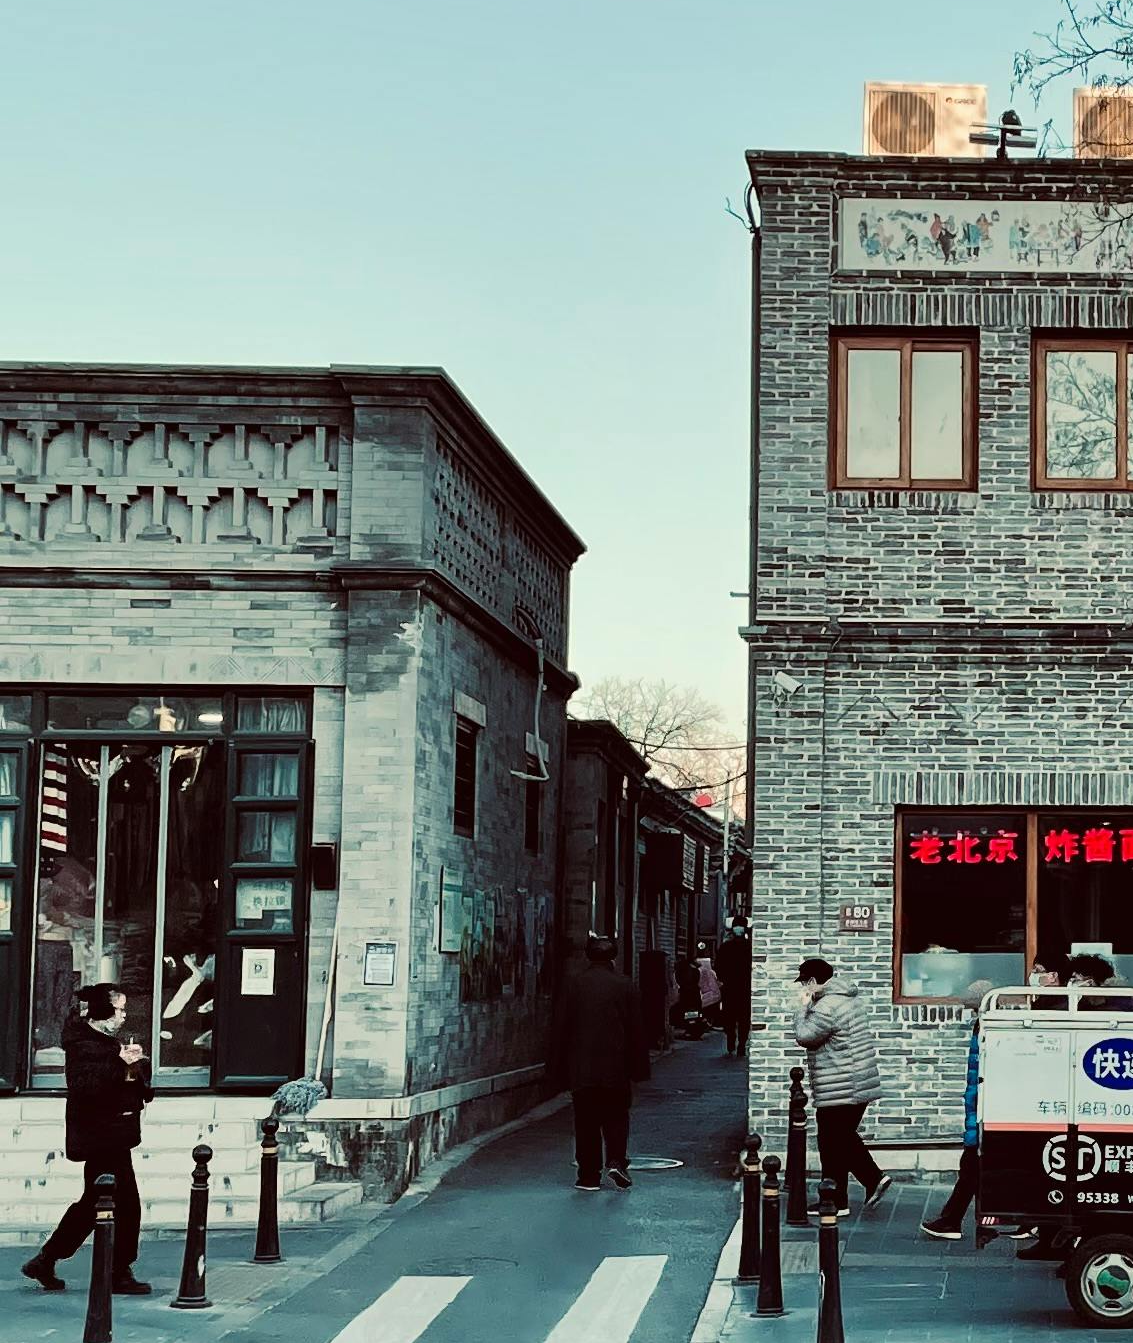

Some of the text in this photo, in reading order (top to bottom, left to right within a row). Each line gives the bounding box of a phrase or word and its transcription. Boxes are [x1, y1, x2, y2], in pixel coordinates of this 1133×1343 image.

[909, 829, 1019, 864] 老北京
[853, 906, 871, 919] 80
[1076, 1192, 1119, 1204] 95338
